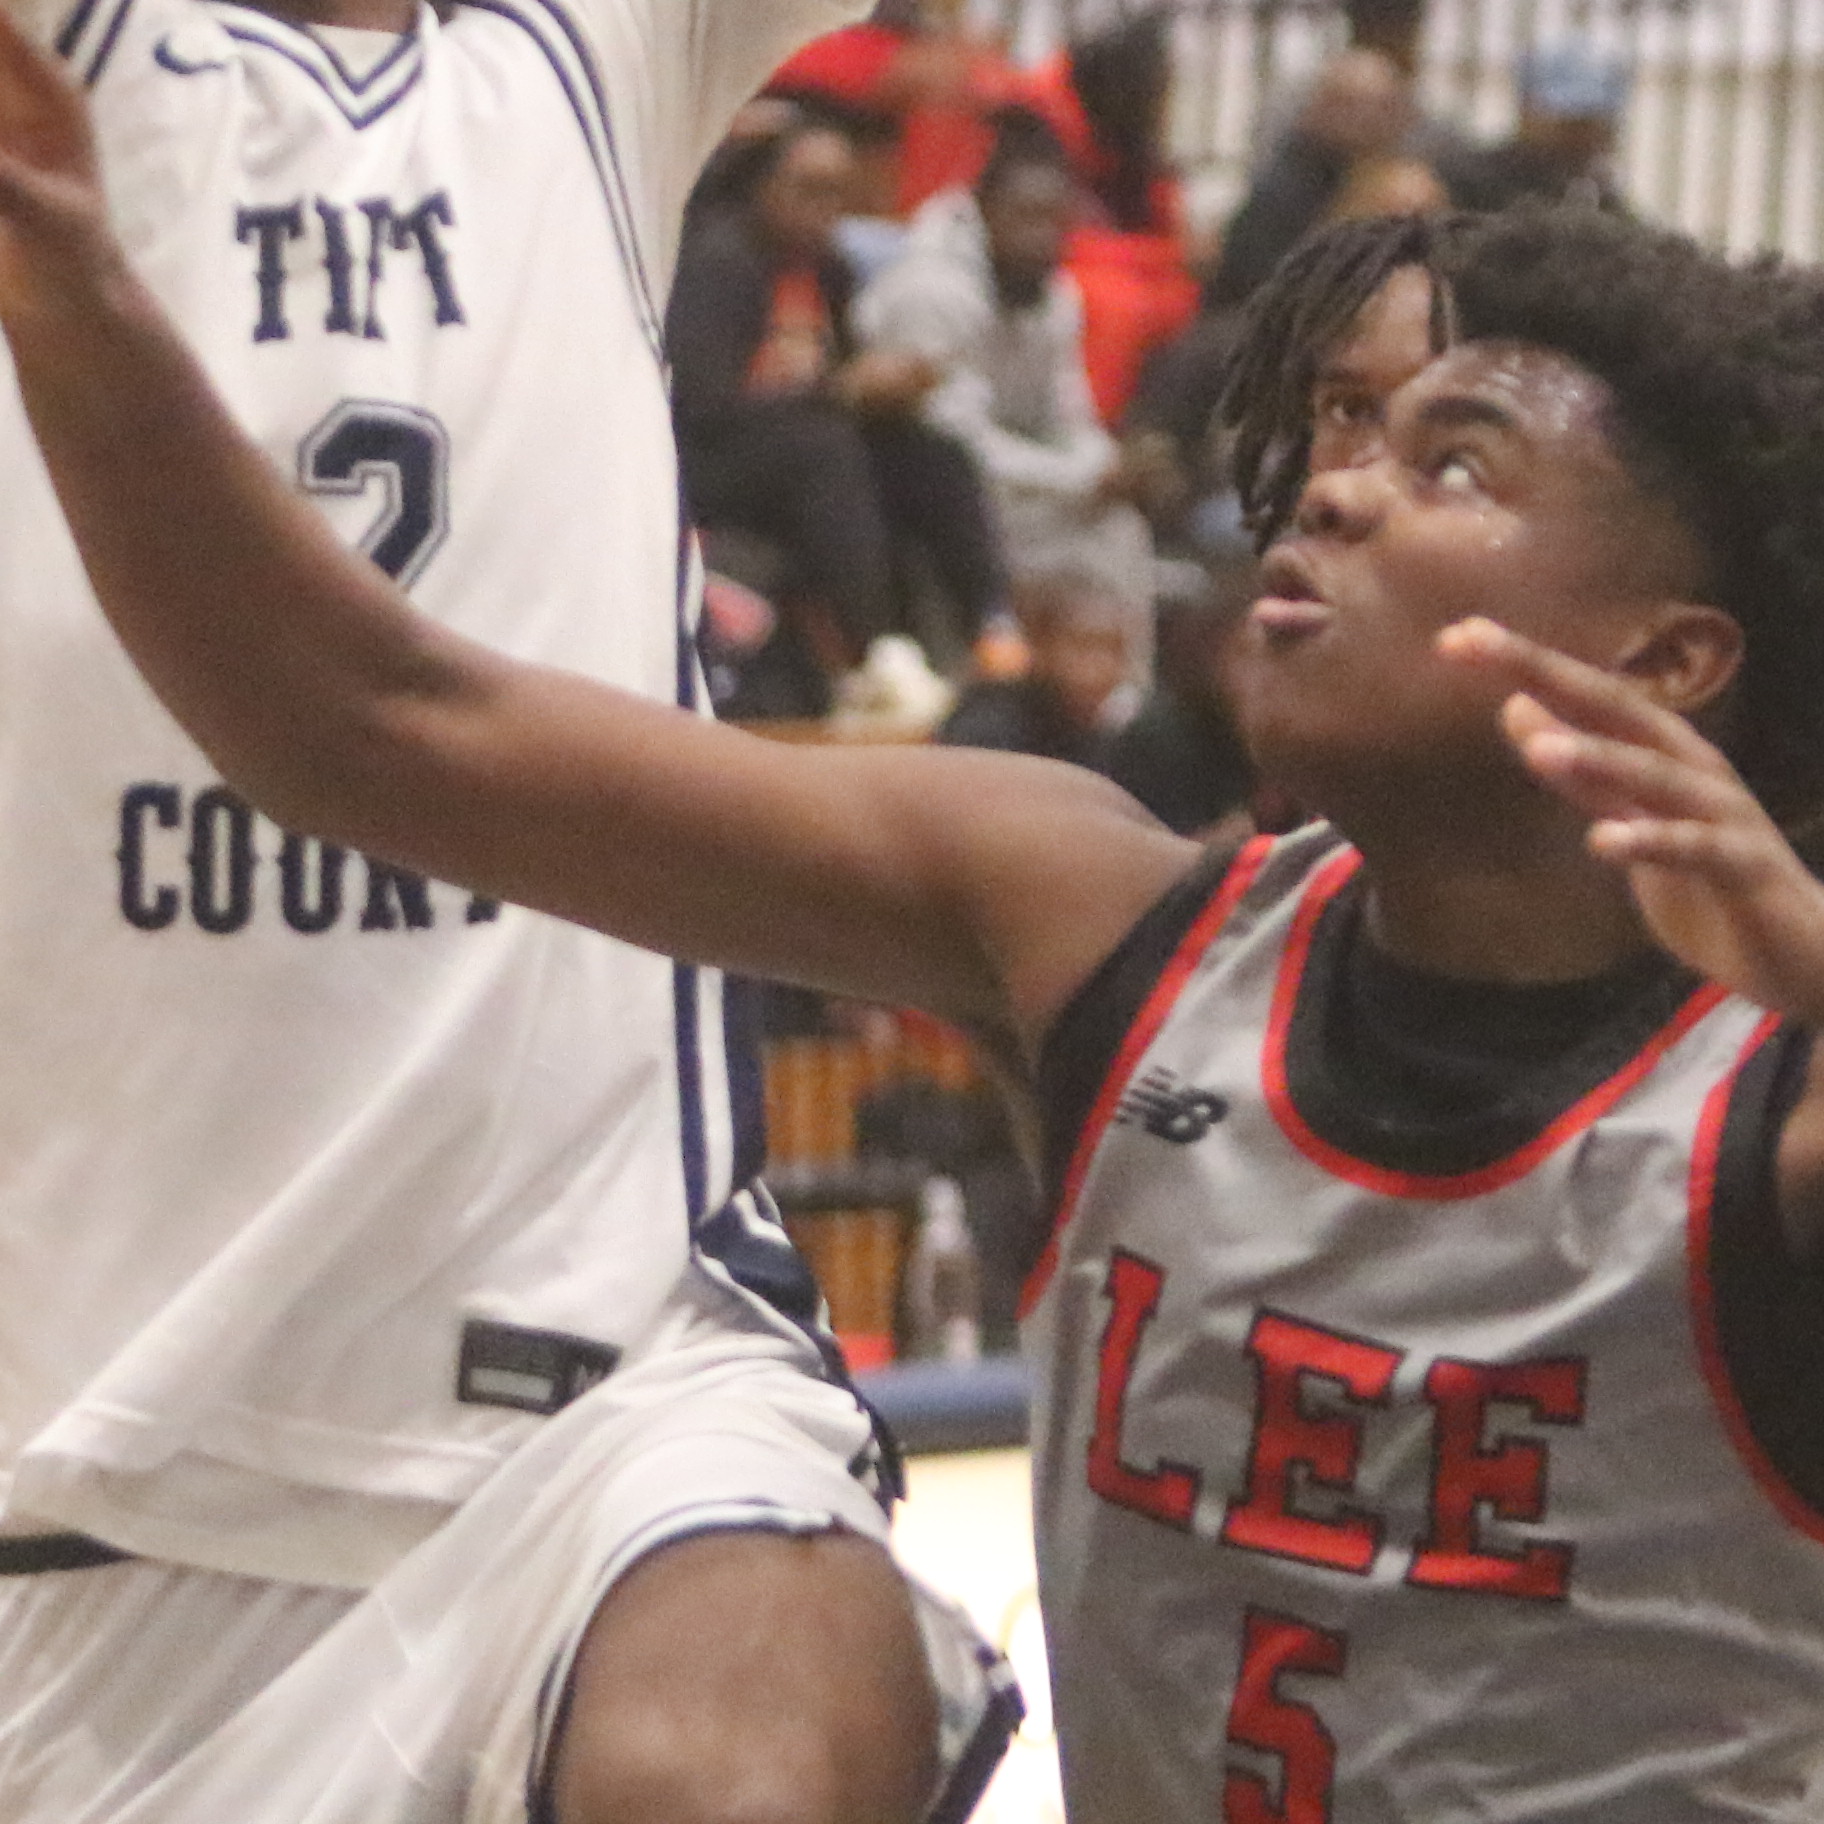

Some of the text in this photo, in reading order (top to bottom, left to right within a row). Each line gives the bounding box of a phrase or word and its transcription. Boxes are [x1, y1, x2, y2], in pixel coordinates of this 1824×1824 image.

[297, 397, 452, 596] 2
[1086, 1245, 1589, 1601] LEE
[1222, 1603, 1350, 1824] 5
